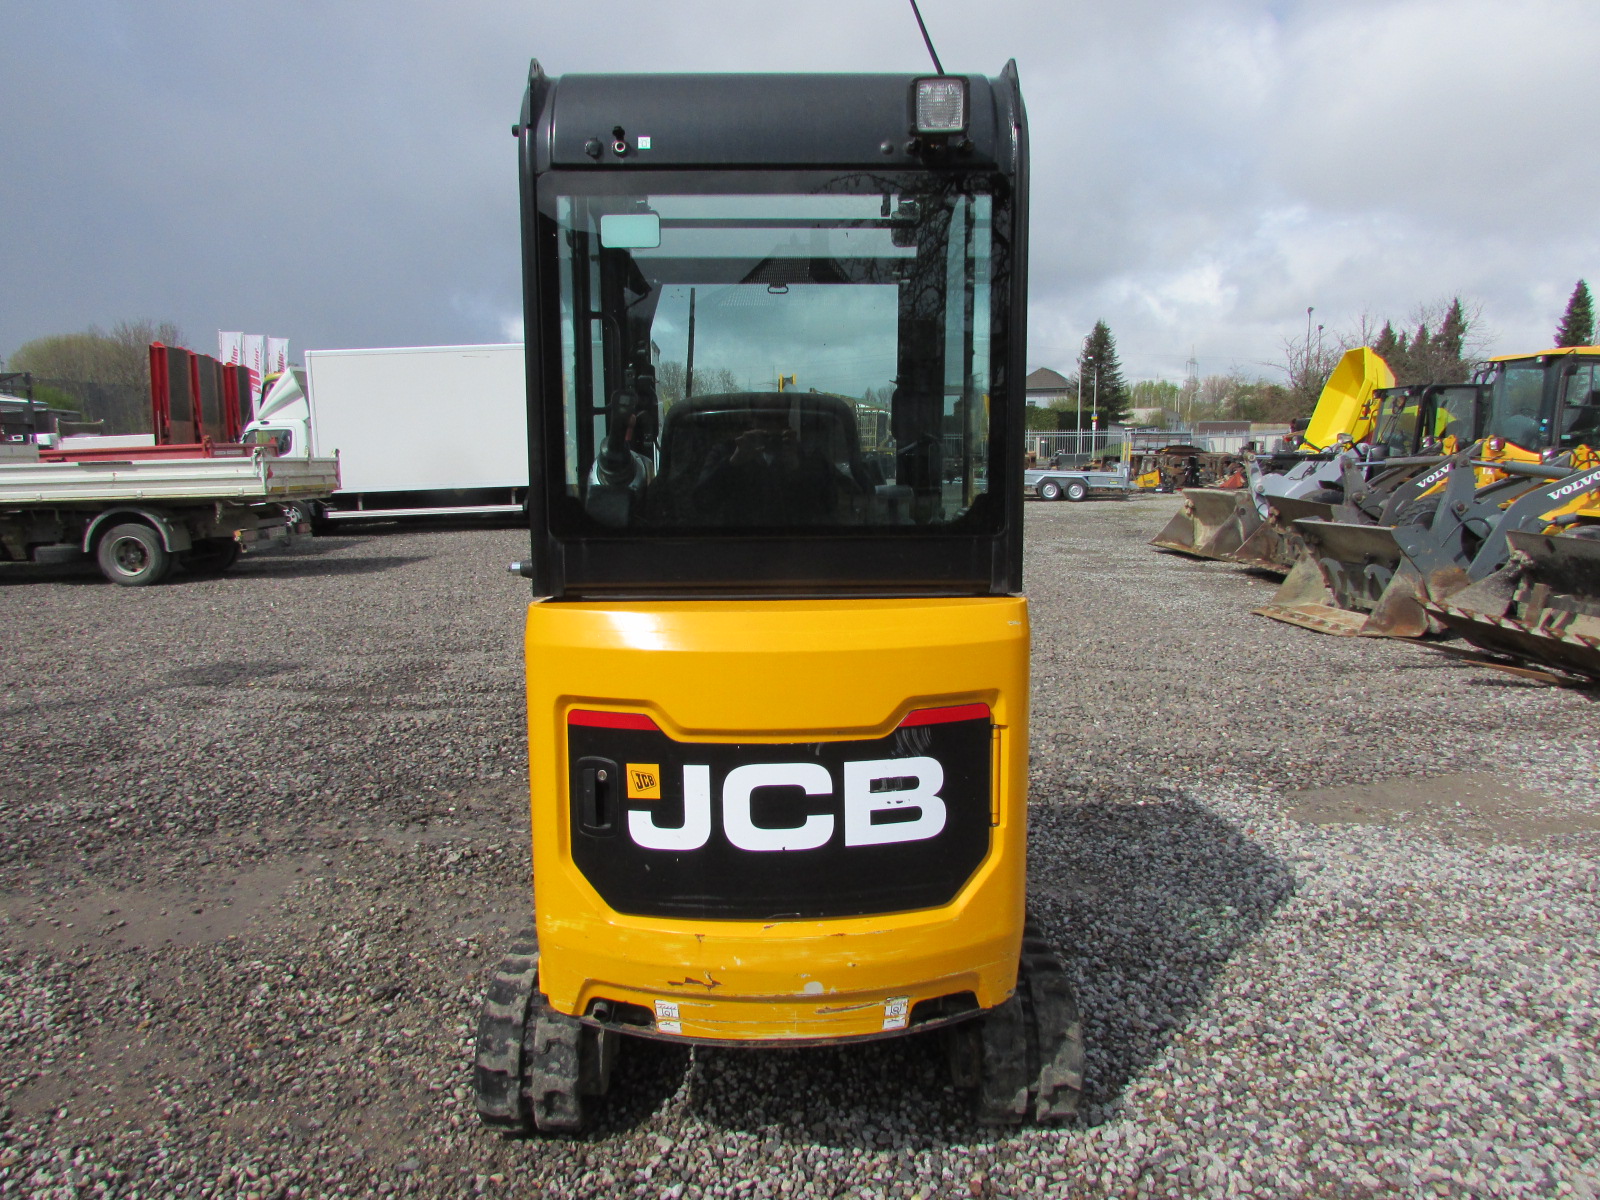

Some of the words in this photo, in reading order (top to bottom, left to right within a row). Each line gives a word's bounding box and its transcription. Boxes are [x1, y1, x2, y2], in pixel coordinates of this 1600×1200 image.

[1416, 463, 1451, 488] VOLV
[635, 772, 655, 790] JCB
[627, 756, 947, 851] JCB
